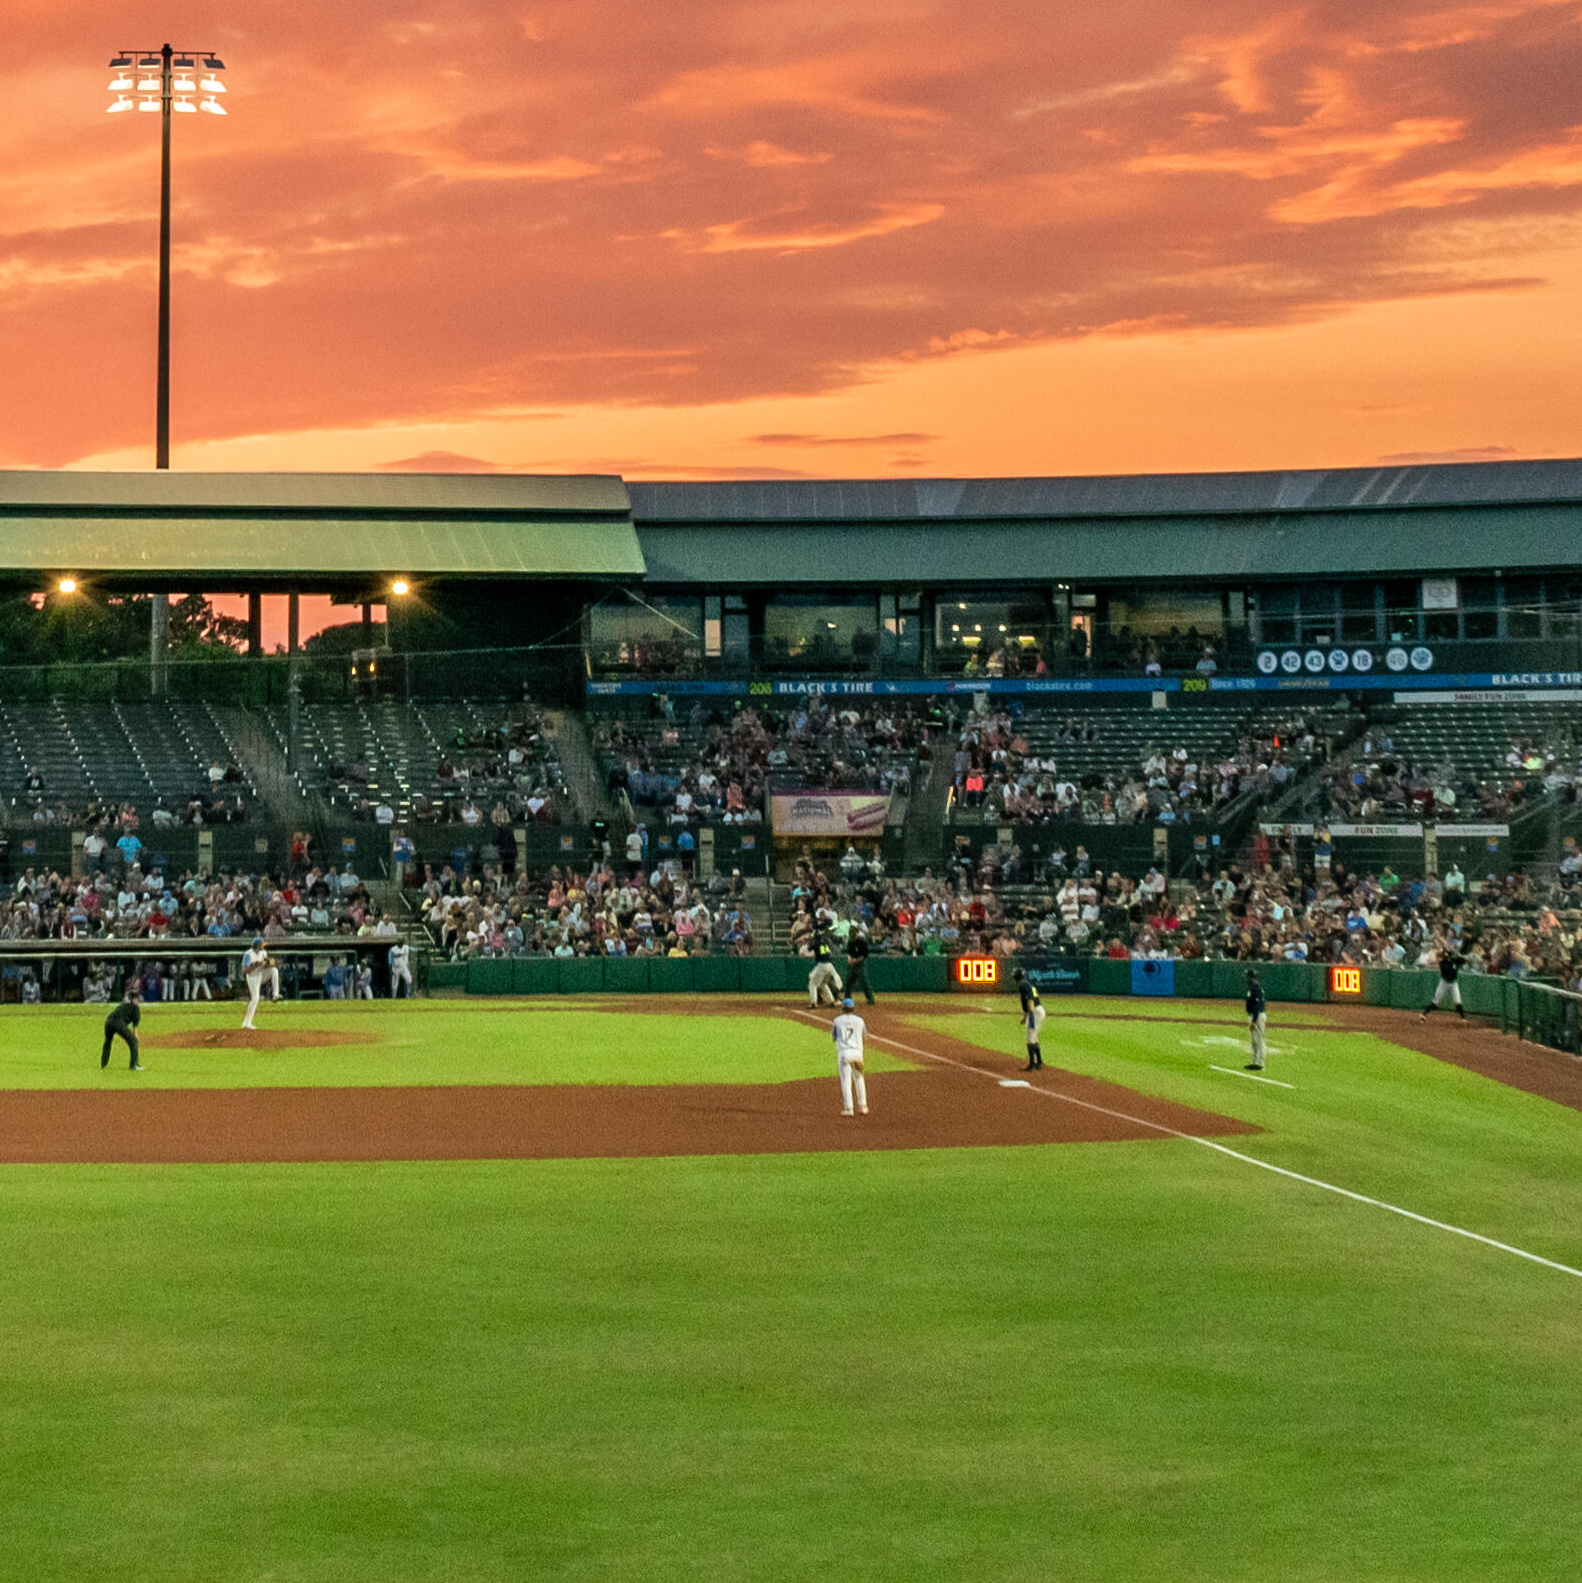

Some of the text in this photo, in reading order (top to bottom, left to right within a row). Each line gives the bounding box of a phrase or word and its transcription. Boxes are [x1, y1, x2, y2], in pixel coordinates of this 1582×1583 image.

[1284, 655, 1298, 667] 42
[1491, 672, 1553, 685] BLACK'S
[779, 682, 873, 693] BLACK'S TIRE
[959, 959, 996, 982] 008
[1333, 968, 1361, 993] 008
